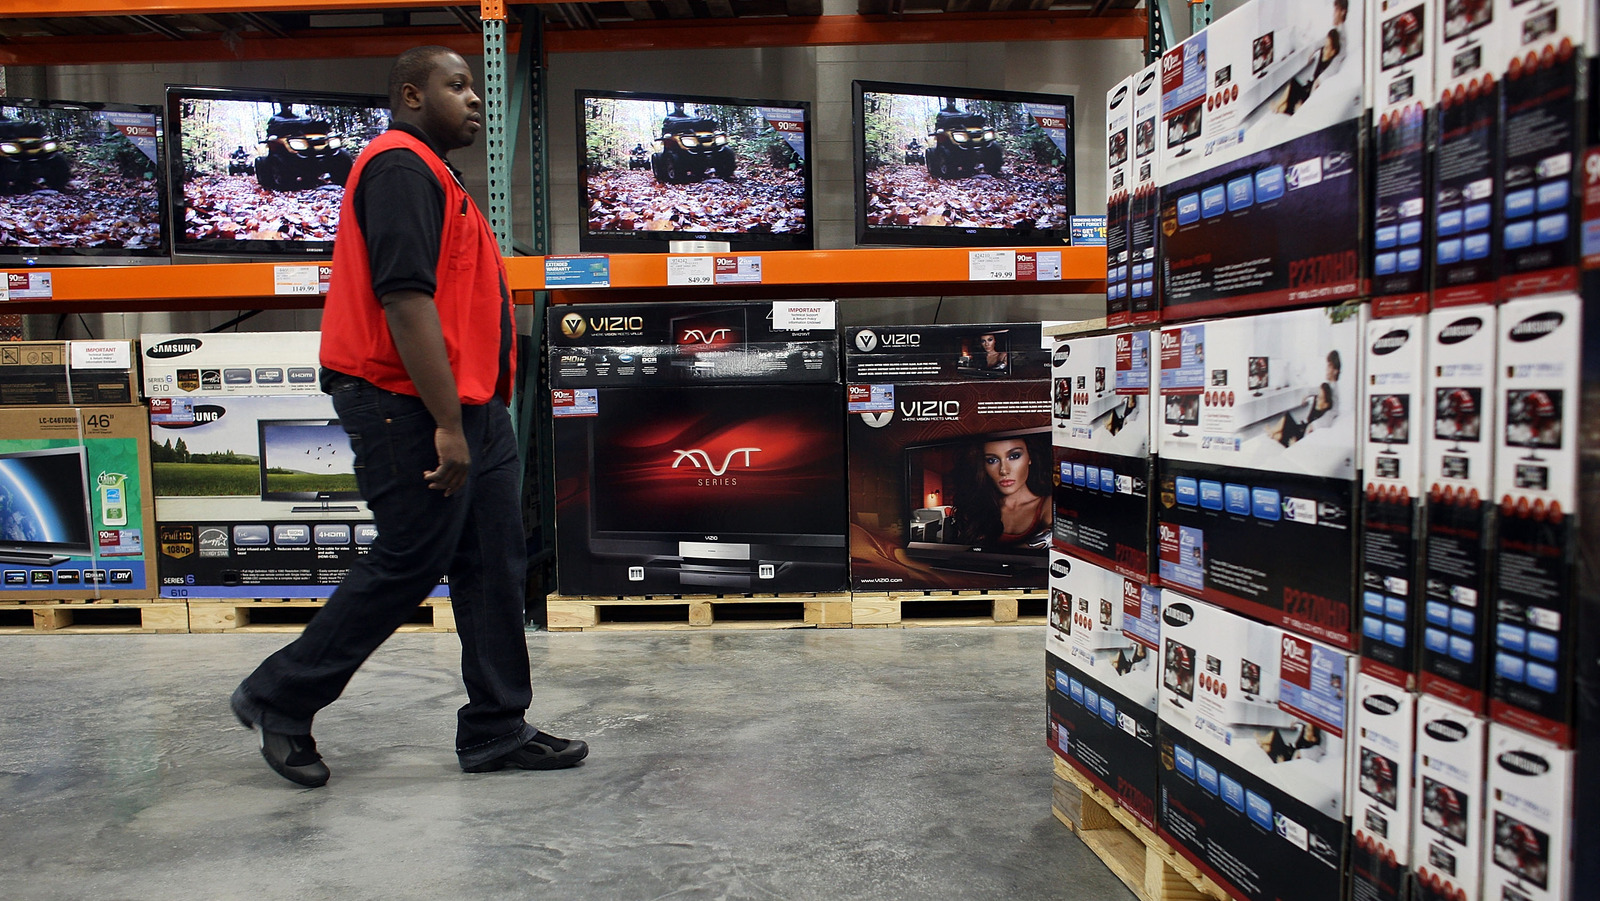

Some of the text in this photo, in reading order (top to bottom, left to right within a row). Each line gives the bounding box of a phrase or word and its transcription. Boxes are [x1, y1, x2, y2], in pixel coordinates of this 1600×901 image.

[1164, 54, 1172, 73] 90
[778, 122, 788, 130] 90
[1042, 118, 1052, 126] 90
[126, 126, 138, 135] 90
[1586, 154, 1600, 185] 9
[590, 316, 644, 331] VIZIO
[1442, 324, 1478, 338] SAMSUNG
[1513, 319, 1560, 334] SAMSUNG
[684, 328, 731, 344] XVT
[881, 334, 920, 344] VIZIO
[1161, 333, 1170, 349] 90
[1374, 336, 1406, 350] SAMSUNG
[152, 344, 196, 353] SAMSUNG
[900, 400, 960, 416] VIZIO
[87, 414, 114, 428] 46"
[672, 448, 762, 476] XVT
[698, 478, 737, 486] SERIES
[164, 530, 178, 540] Full
[1160, 525, 1168, 541] 90
[166, 546, 190, 554] 1080p
[1051, 563, 1069, 574] SAMSUNG
[186, 574, 195, 584] 6
[170, 589, 188, 597] 610
[1125, 581, 1132, 596] 90
[1165, 608, 1192, 624] SAMSUNG
[1282, 638, 1296, 658] 90
[1364, 696, 1398, 713] SAMSUNG
[1428, 722, 1466, 740] SAMSUNG
[1501, 753, 1546, 774] SAMSUNG
